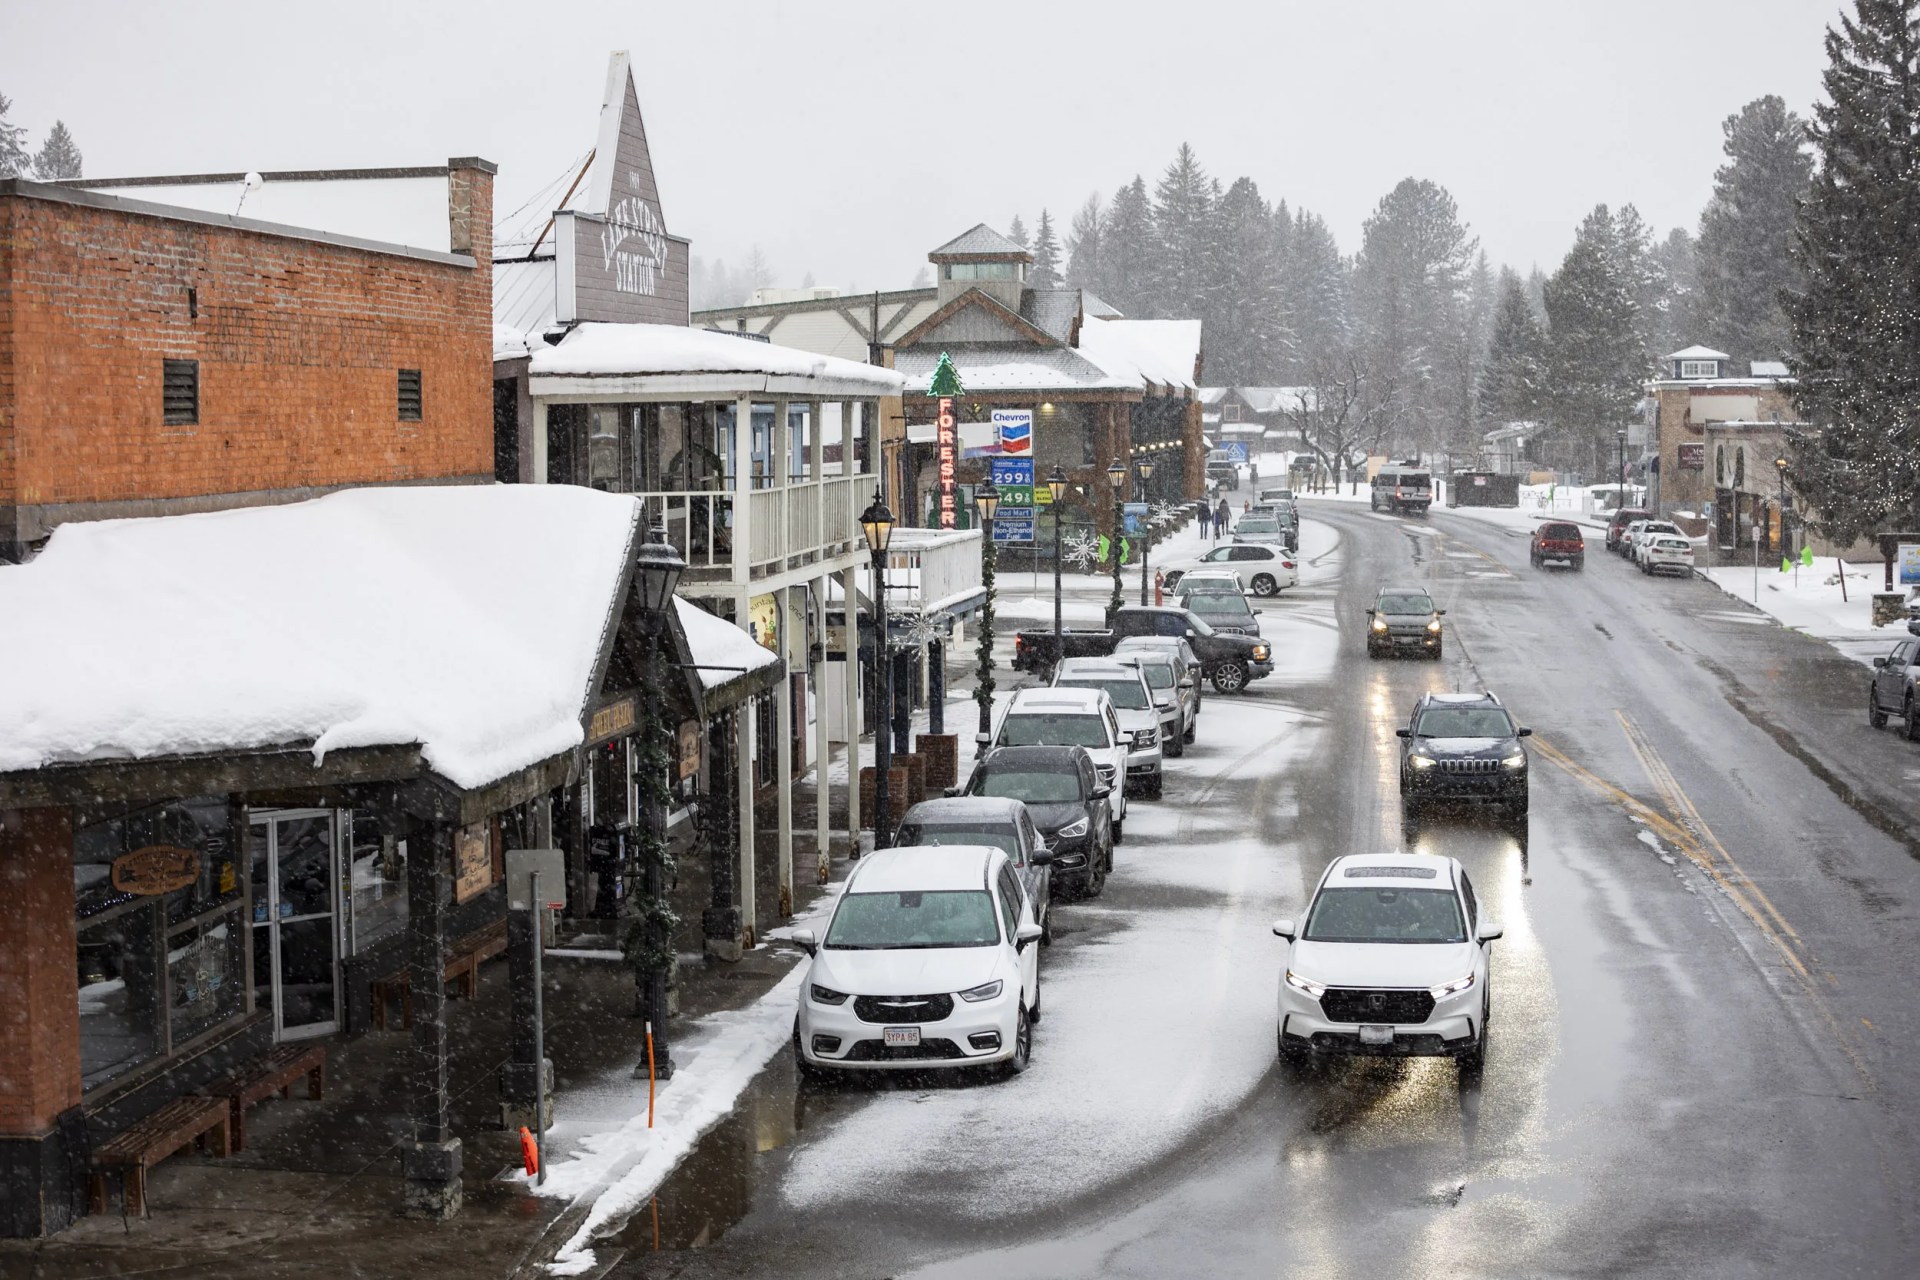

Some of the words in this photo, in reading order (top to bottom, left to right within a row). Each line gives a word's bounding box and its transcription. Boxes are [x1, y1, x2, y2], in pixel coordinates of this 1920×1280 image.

[993, 413, 1030, 421] Chevron
[940, 398, 955, 530] FORESTER
[788, 602, 806, 621] onet
